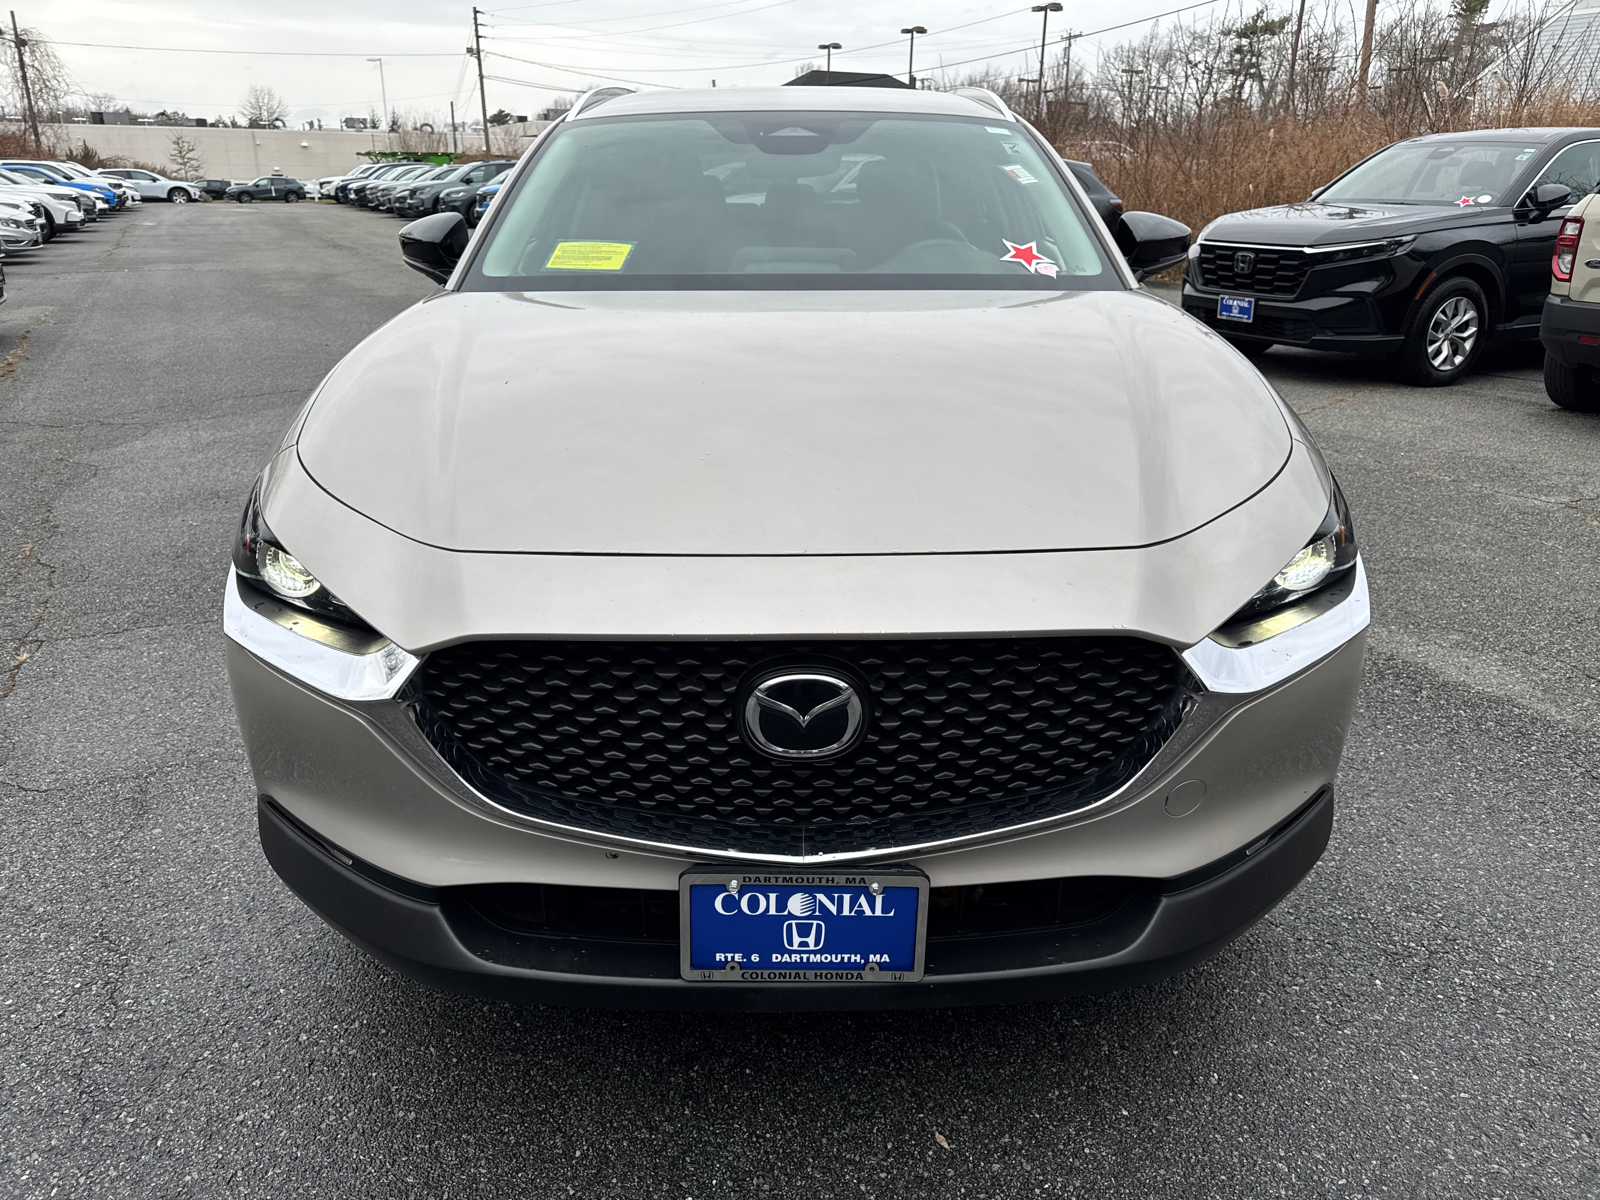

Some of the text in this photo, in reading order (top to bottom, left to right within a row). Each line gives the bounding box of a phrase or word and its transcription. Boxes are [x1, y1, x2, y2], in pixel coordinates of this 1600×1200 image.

[742, 876, 867, 885] DARTMOUTH, MA
[714, 892, 895, 917] COLONIAL
[715, 953, 890, 965] RTE. 6 DARTMOUTH, MA
[740, 971, 864, 981] COLONIAL HONDA
